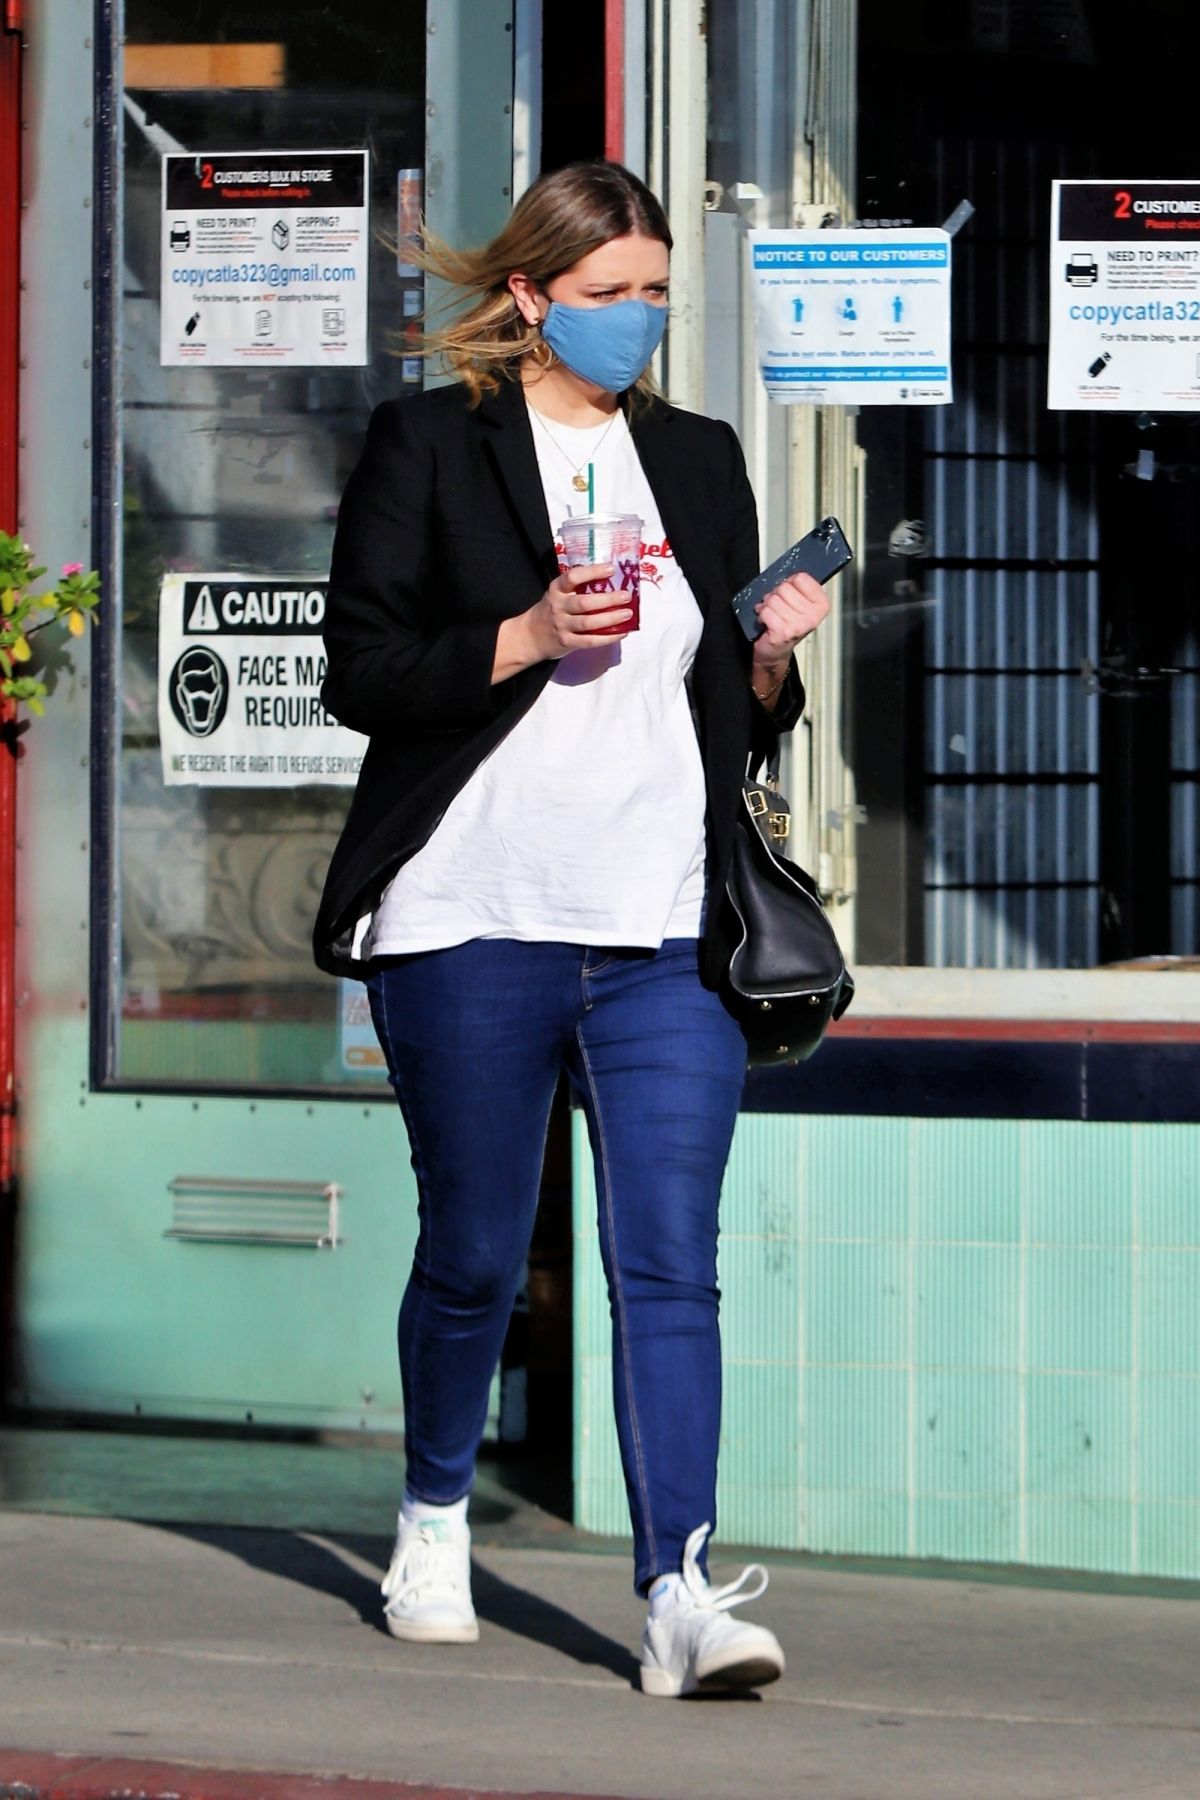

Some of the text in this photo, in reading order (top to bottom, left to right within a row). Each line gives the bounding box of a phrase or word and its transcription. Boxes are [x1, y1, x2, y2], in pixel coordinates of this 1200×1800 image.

[201, 163, 333, 188] 2 CUSTOMERS MAX IN STORE
[1114, 191, 1132, 218] 2
[197, 217, 257, 228] NEED TO PRINT?
[296, 216, 340, 228] SHIPPING?
[1145, 219, 1176, 229] Please
[755, 250, 946, 262] NOTICE TO OUR CUSTOMERS
[1107, 250, 1199, 262] NEED TO PRINT?
[172, 264, 356, 287] copycatla323@gmail.com
[262, 294, 276, 302] NOT
[1101, 332, 1113, 341] For
[1116, 333, 1128, 341] the
[1131, 333, 1148, 341] time
[1150, 333, 1175, 344] being,
[222, 591, 327, 625] CAUTIO
[237, 656, 329, 686] FACE MA
[172, 755, 186, 773] WE
[188, 755, 227, 773] RESERVE
[230, 755, 246, 773] THE
[249, 755, 274, 773] RIGHT
[277, 755, 289, 773] TO
[290, 755, 324, 773] REFUSE
